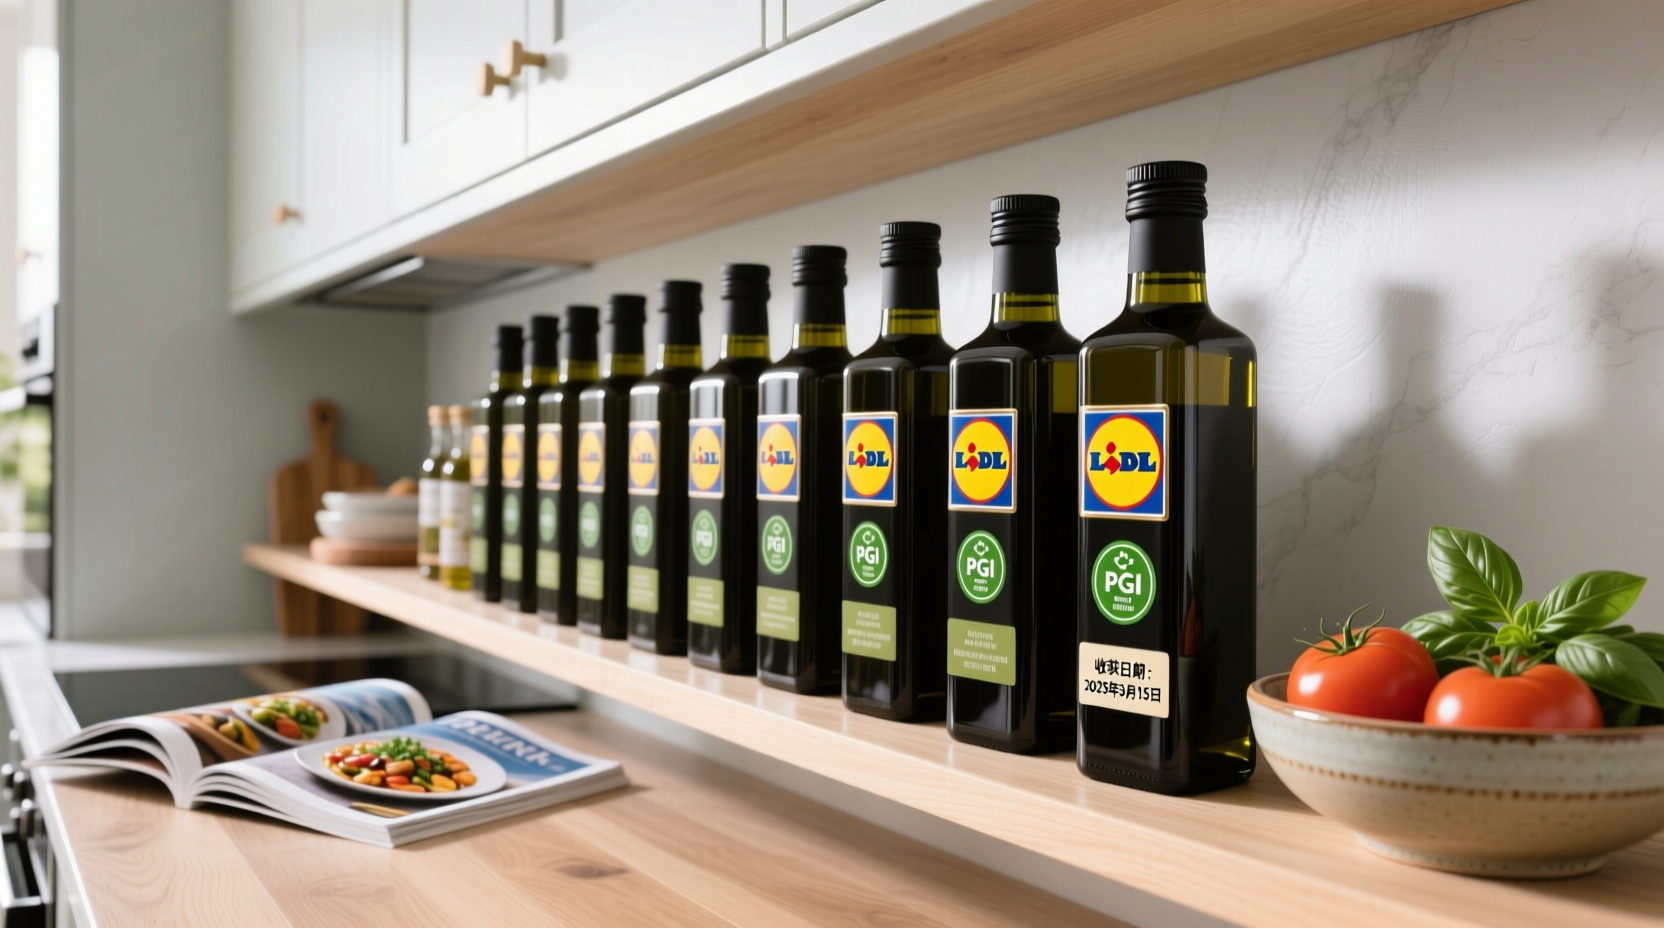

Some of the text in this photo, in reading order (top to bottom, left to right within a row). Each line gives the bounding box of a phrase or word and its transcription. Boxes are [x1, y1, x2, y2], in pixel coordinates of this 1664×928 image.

[767, 535, 785, 553] PGI
[856, 545, 879, 564] PGI
[966, 557, 995, 578] PGI
[1105, 571, 1141, 595] PGI
[1084, 679, 1161, 703] 2025年3月15日
